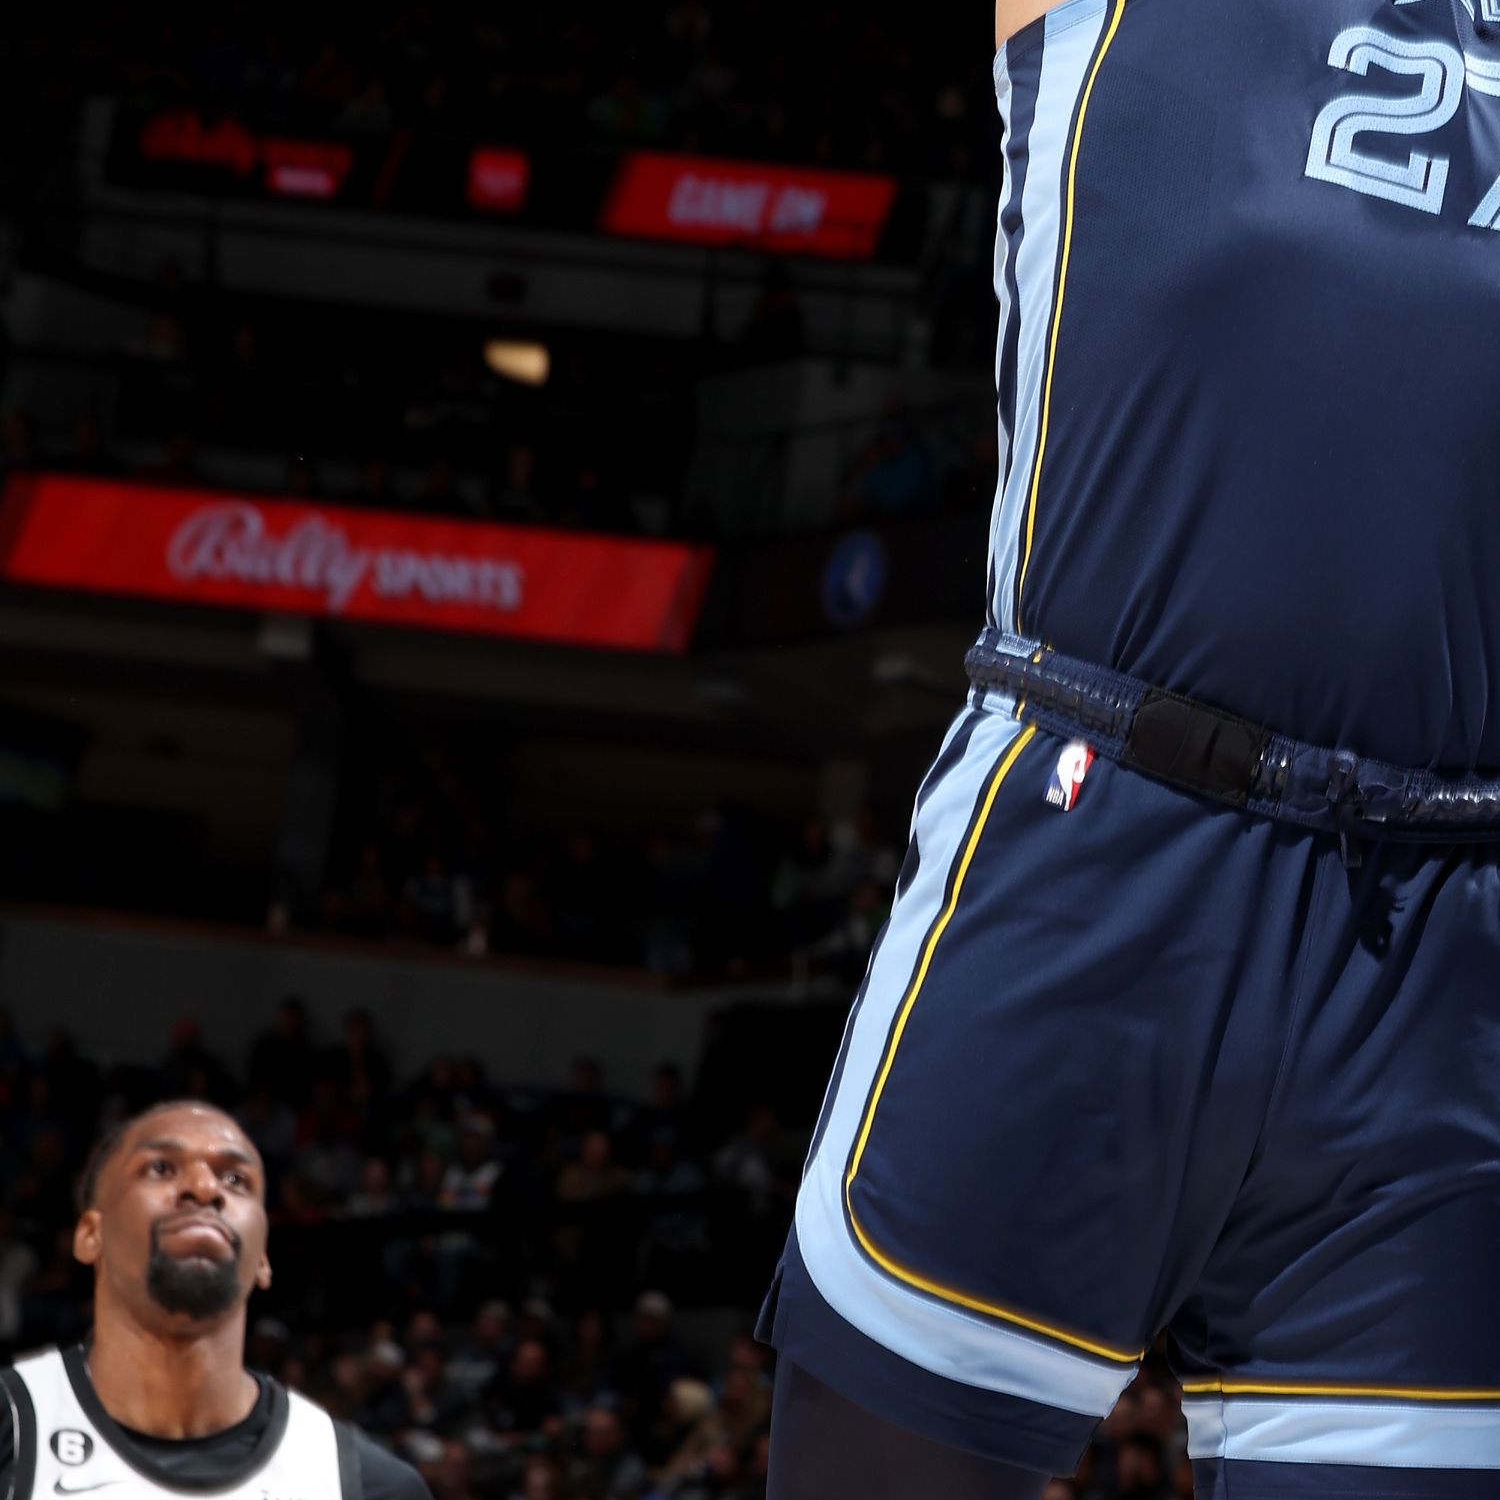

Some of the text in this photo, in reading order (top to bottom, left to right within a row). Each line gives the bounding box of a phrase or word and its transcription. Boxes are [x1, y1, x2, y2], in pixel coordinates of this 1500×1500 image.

[164, 500, 524, 617] Bally SPORTS
[55, 1429, 88, 1464] 6
